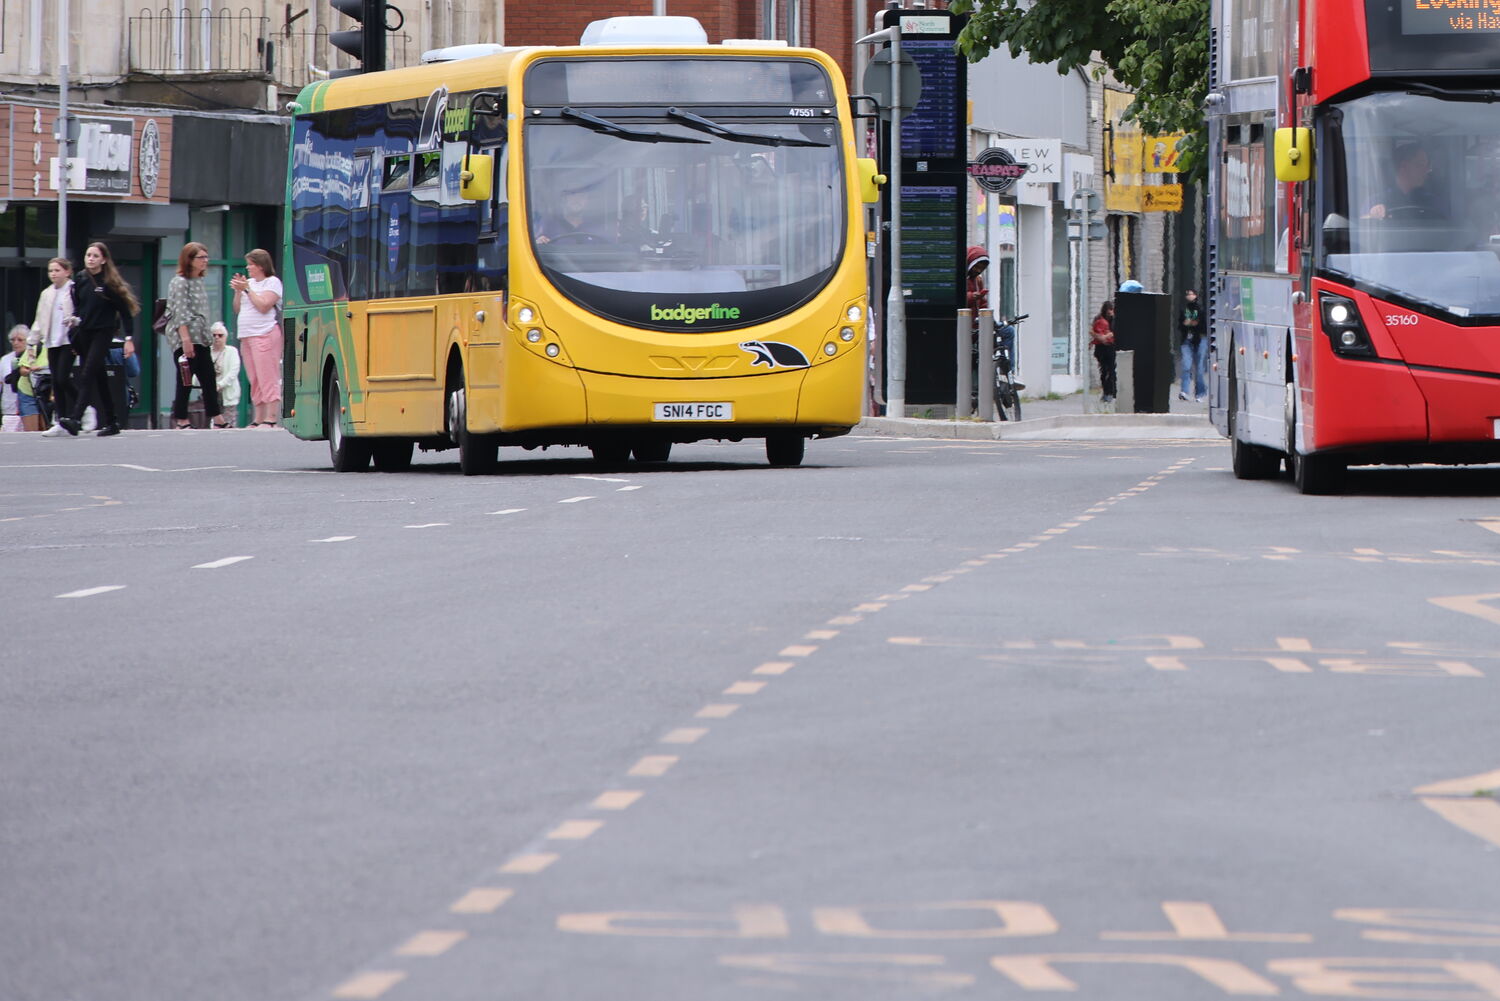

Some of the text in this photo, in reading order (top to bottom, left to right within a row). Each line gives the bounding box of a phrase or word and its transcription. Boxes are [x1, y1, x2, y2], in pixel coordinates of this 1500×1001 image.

[1450, 12, 1473, 30] via
[788, 108, 814, 117] 47551
[650, 303, 741, 324] badgerline
[1385, 314, 1419, 326] 35160
[663, 404, 723, 418] SN14 FGC
